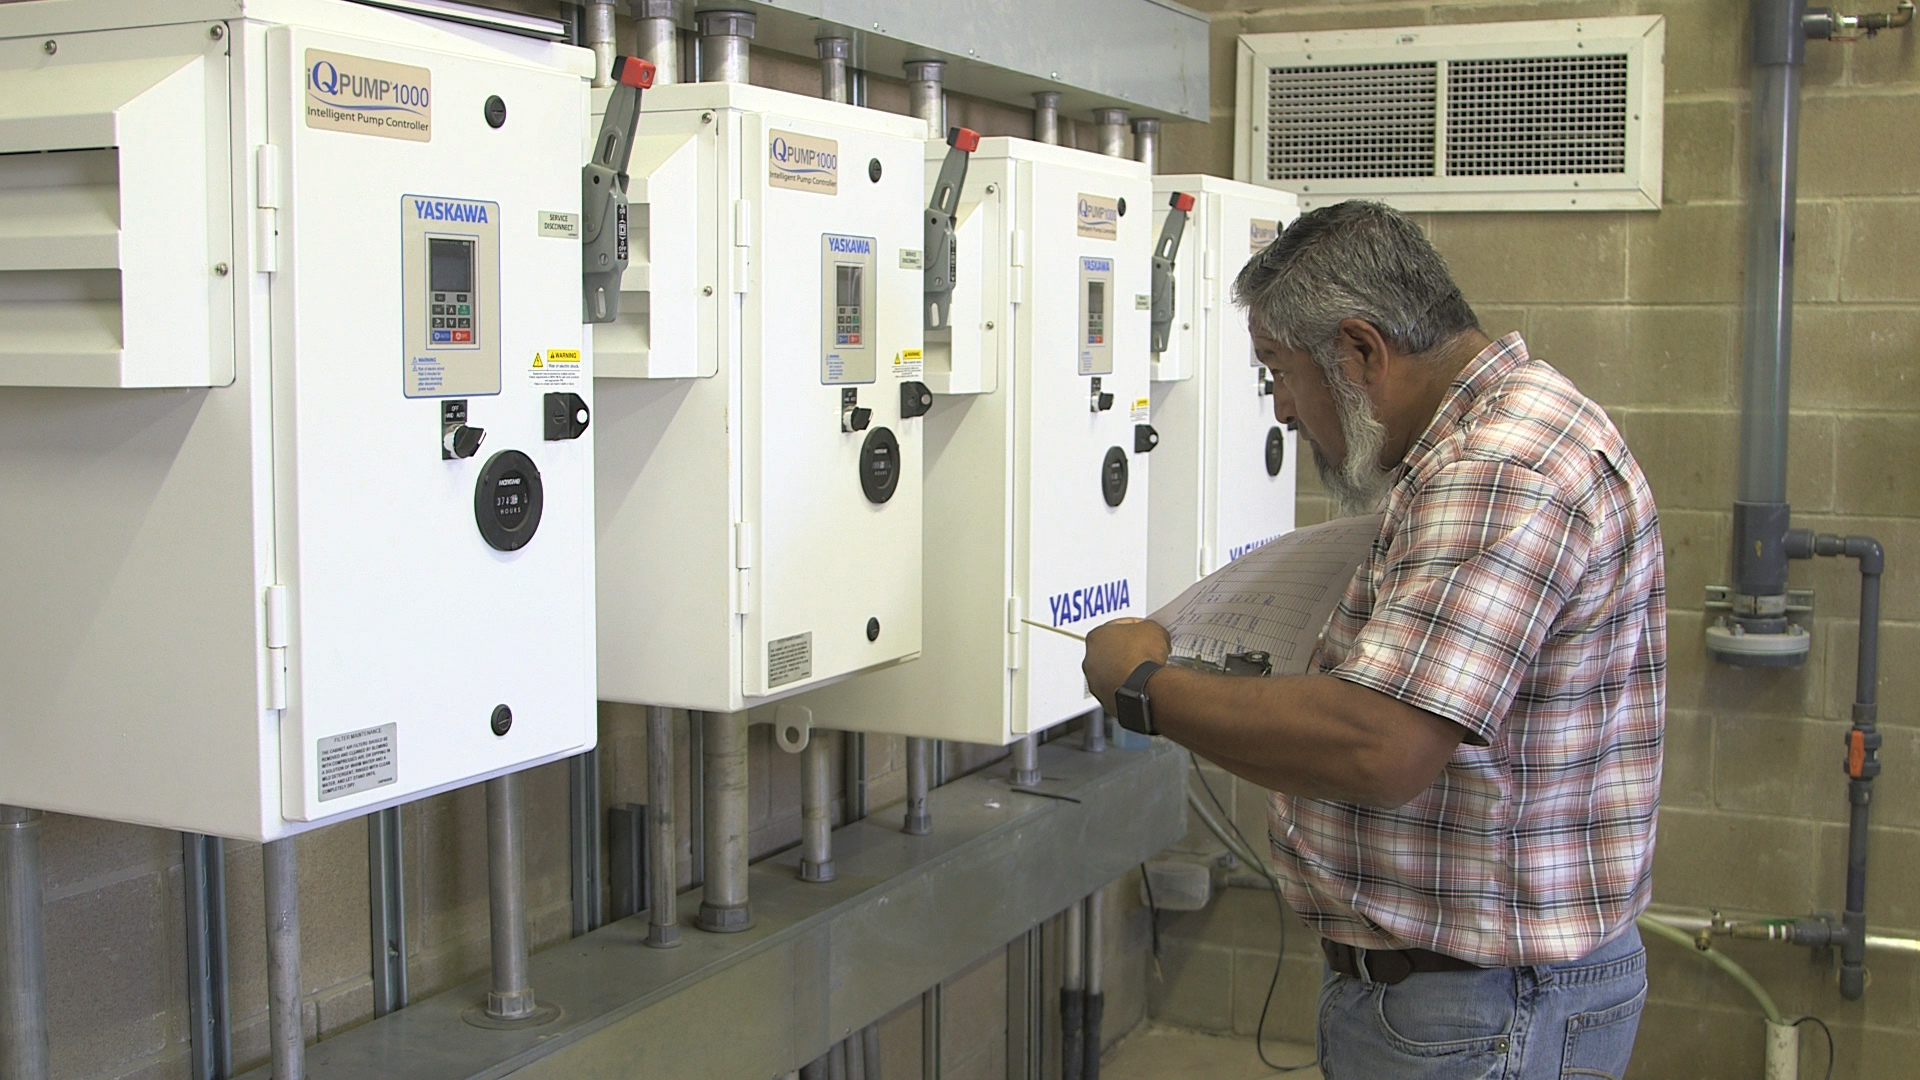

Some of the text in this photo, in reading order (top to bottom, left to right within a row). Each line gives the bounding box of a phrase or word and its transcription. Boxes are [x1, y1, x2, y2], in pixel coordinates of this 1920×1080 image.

[307, 107, 429, 131] Intelligent Pump Controller
[769, 171, 837, 187] Intelligent Pump Controller
[414, 199, 488, 224] YASKAWA
[549, 213, 568, 222] SERVICE
[544, 222, 574, 231] DISCONNECT
[828, 236, 871, 254] YASKAWA
[1084, 260, 1110, 272] YASKAWA
[500, 507, 521, 515] HOURS
[1049, 578, 1130, 627] YASKAWA
[351, 728, 382, 739] MAINTENANCE
